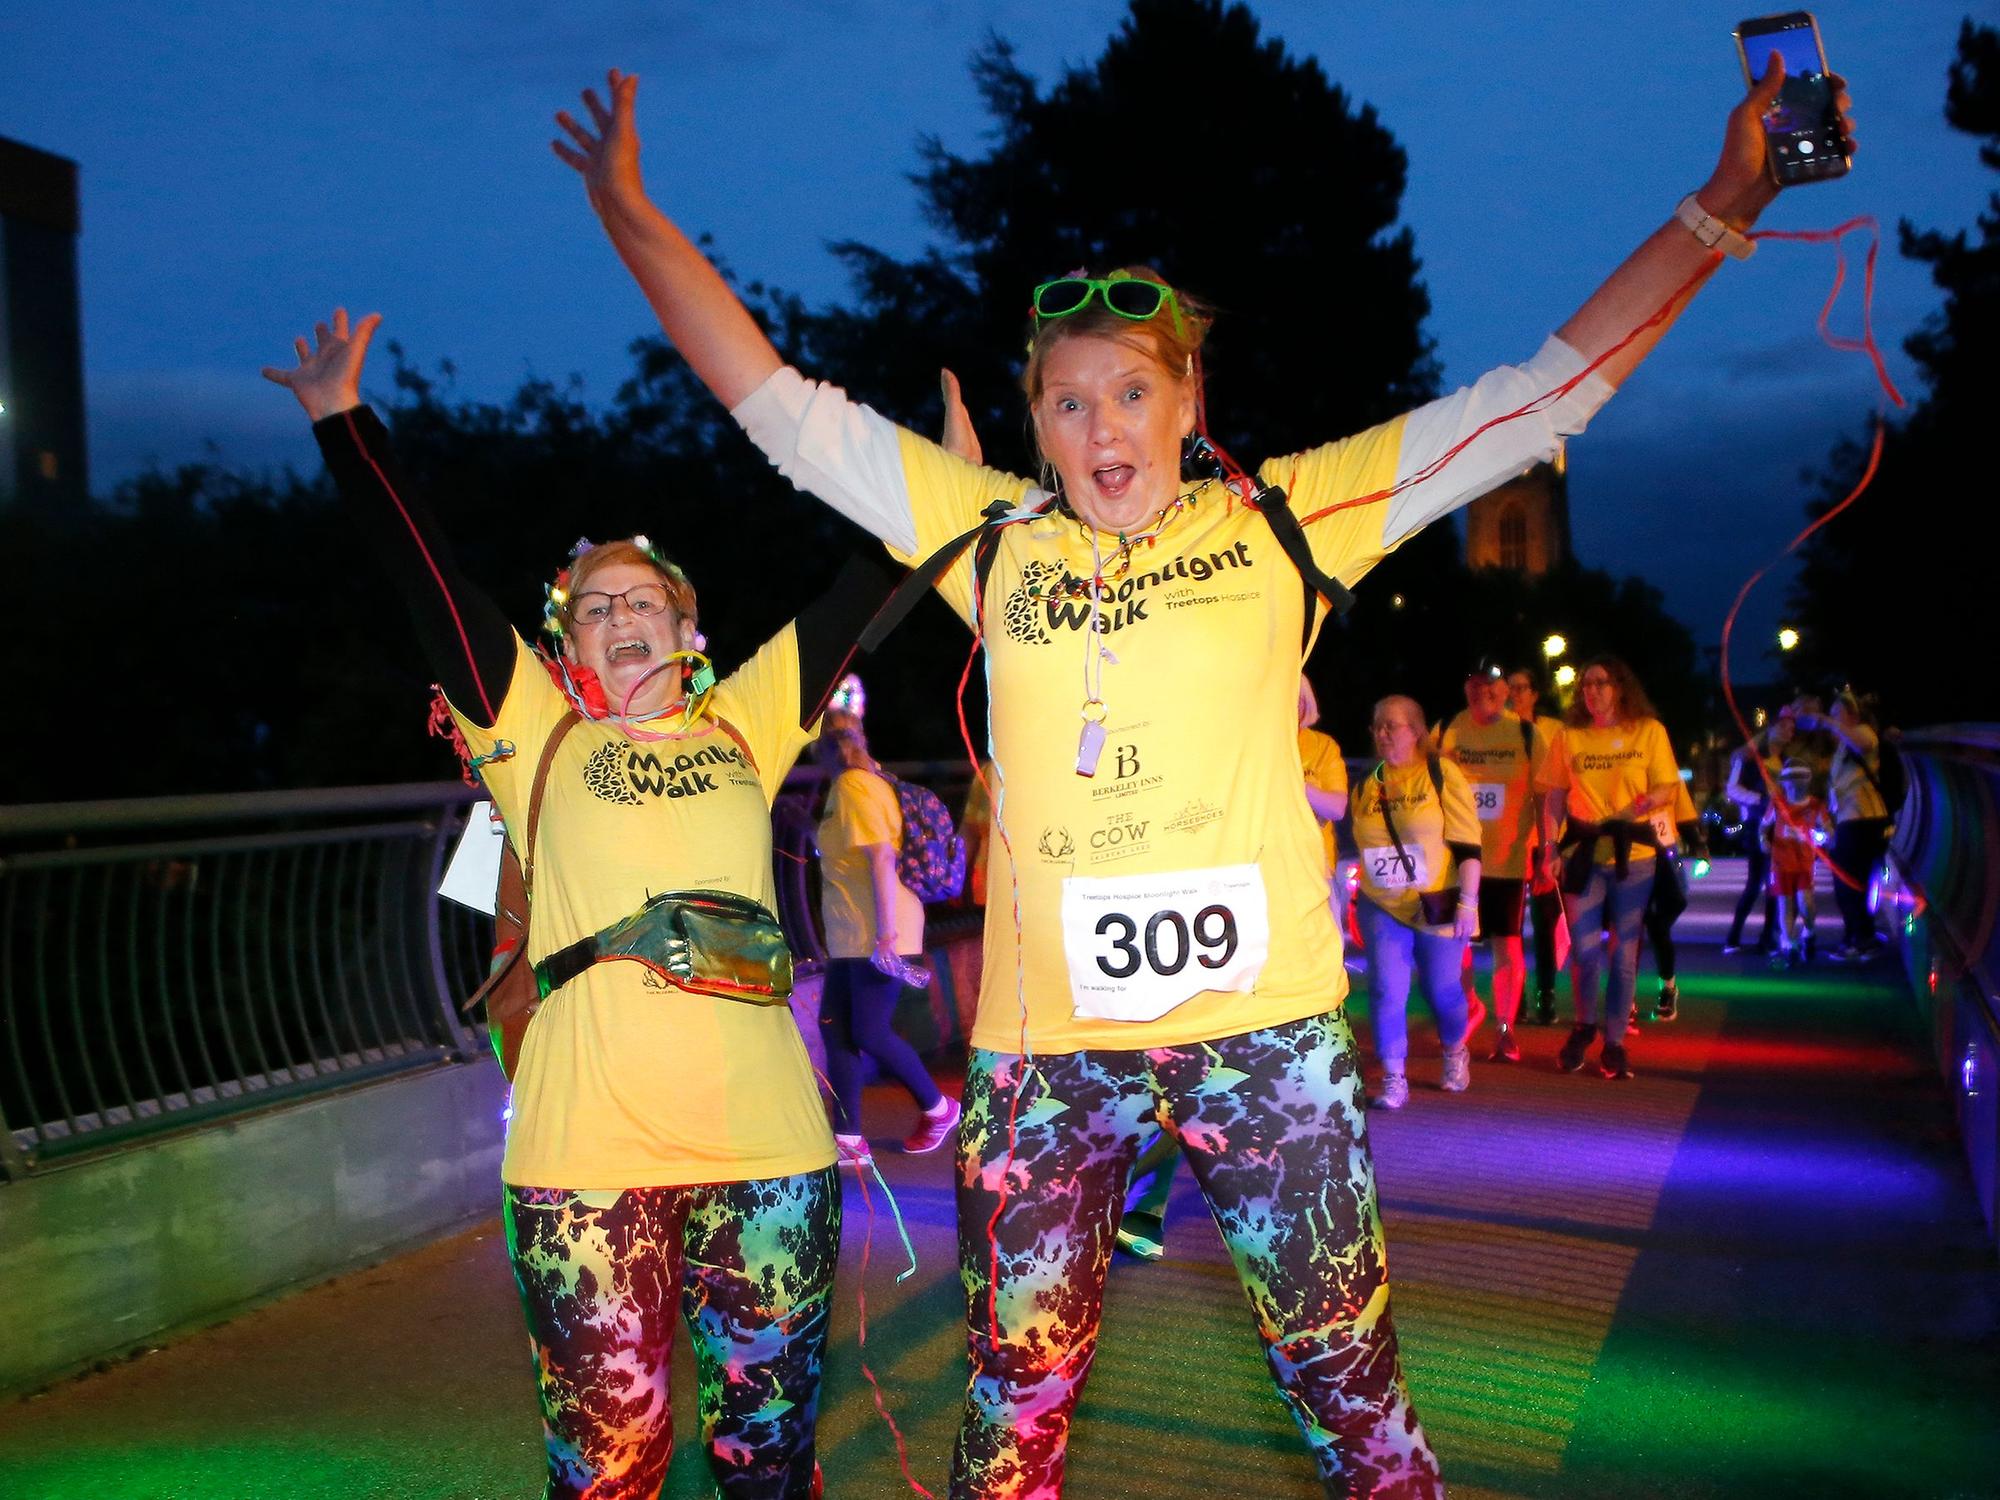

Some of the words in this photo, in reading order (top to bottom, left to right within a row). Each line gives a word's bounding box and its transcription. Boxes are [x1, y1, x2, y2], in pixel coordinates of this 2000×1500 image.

[1165, 593, 1220, 610] Treetops
[1046, 598, 1149, 634] Walk
[1584, 750, 1644, 762] Moonlight
[1584, 762, 1613, 770] Walk
[628, 771, 719, 798] Walk
[1092, 780, 1138, 797] BERKELEY
[1139, 774, 1164, 787] INNS
[1106, 811, 1134, 825] THE
[1090, 820, 1150, 848] COW
[1095, 904, 1239, 979] 309
